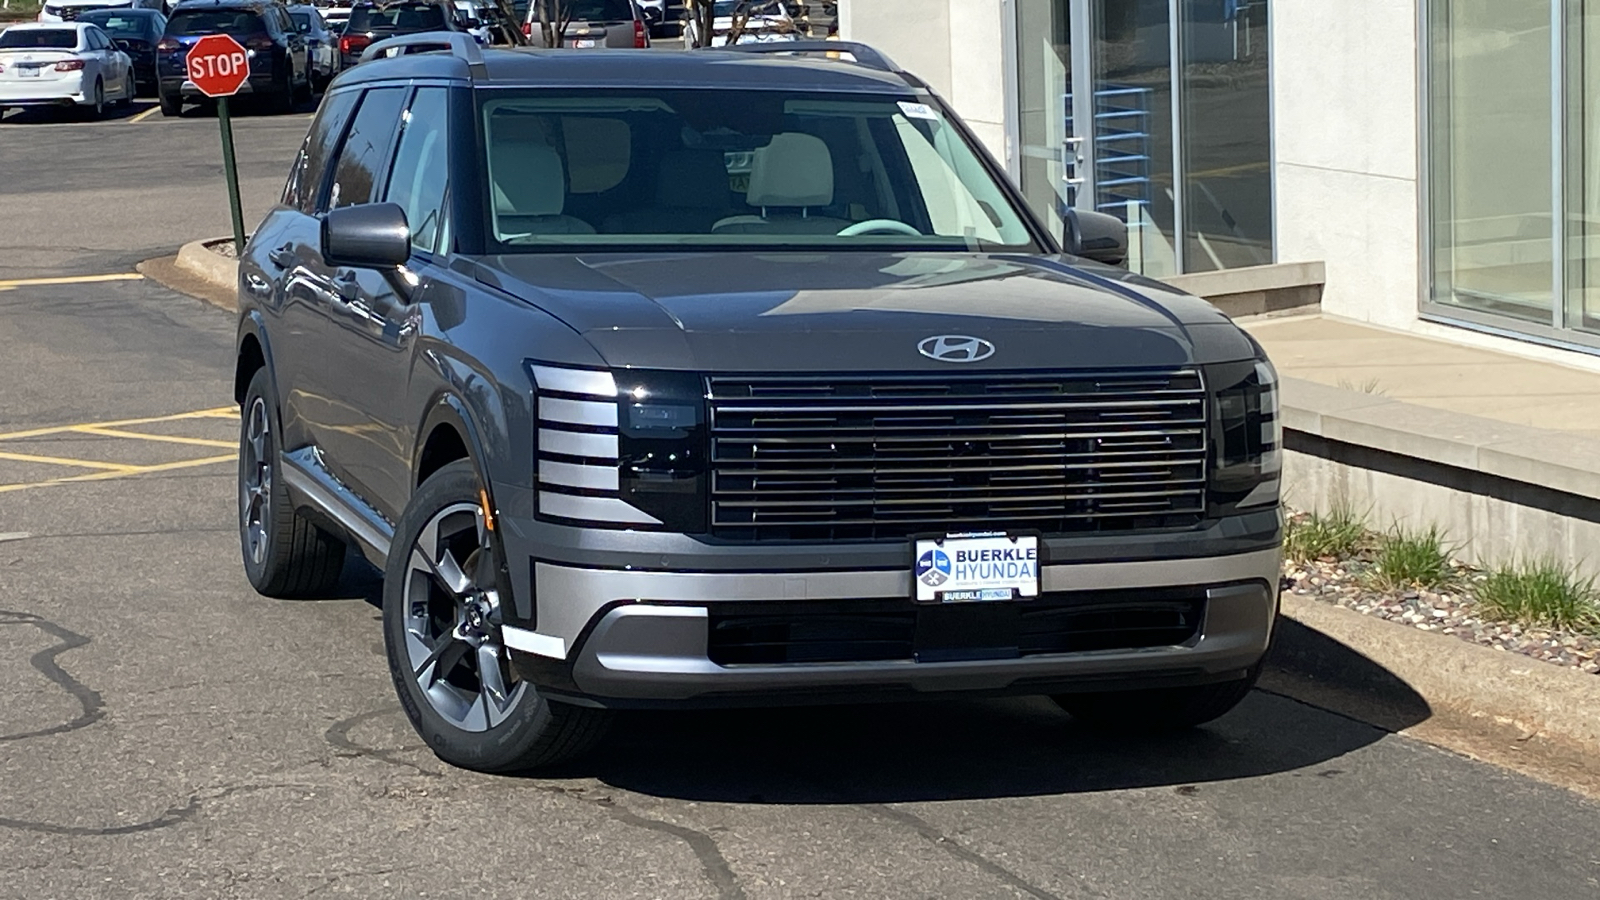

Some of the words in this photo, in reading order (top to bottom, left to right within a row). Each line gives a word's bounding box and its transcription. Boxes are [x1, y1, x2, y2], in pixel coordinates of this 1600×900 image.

[191, 52, 244, 79] STOP
[956, 548, 1036, 562] BUERKLE
[956, 562, 1037, 580] HYUNDAI
